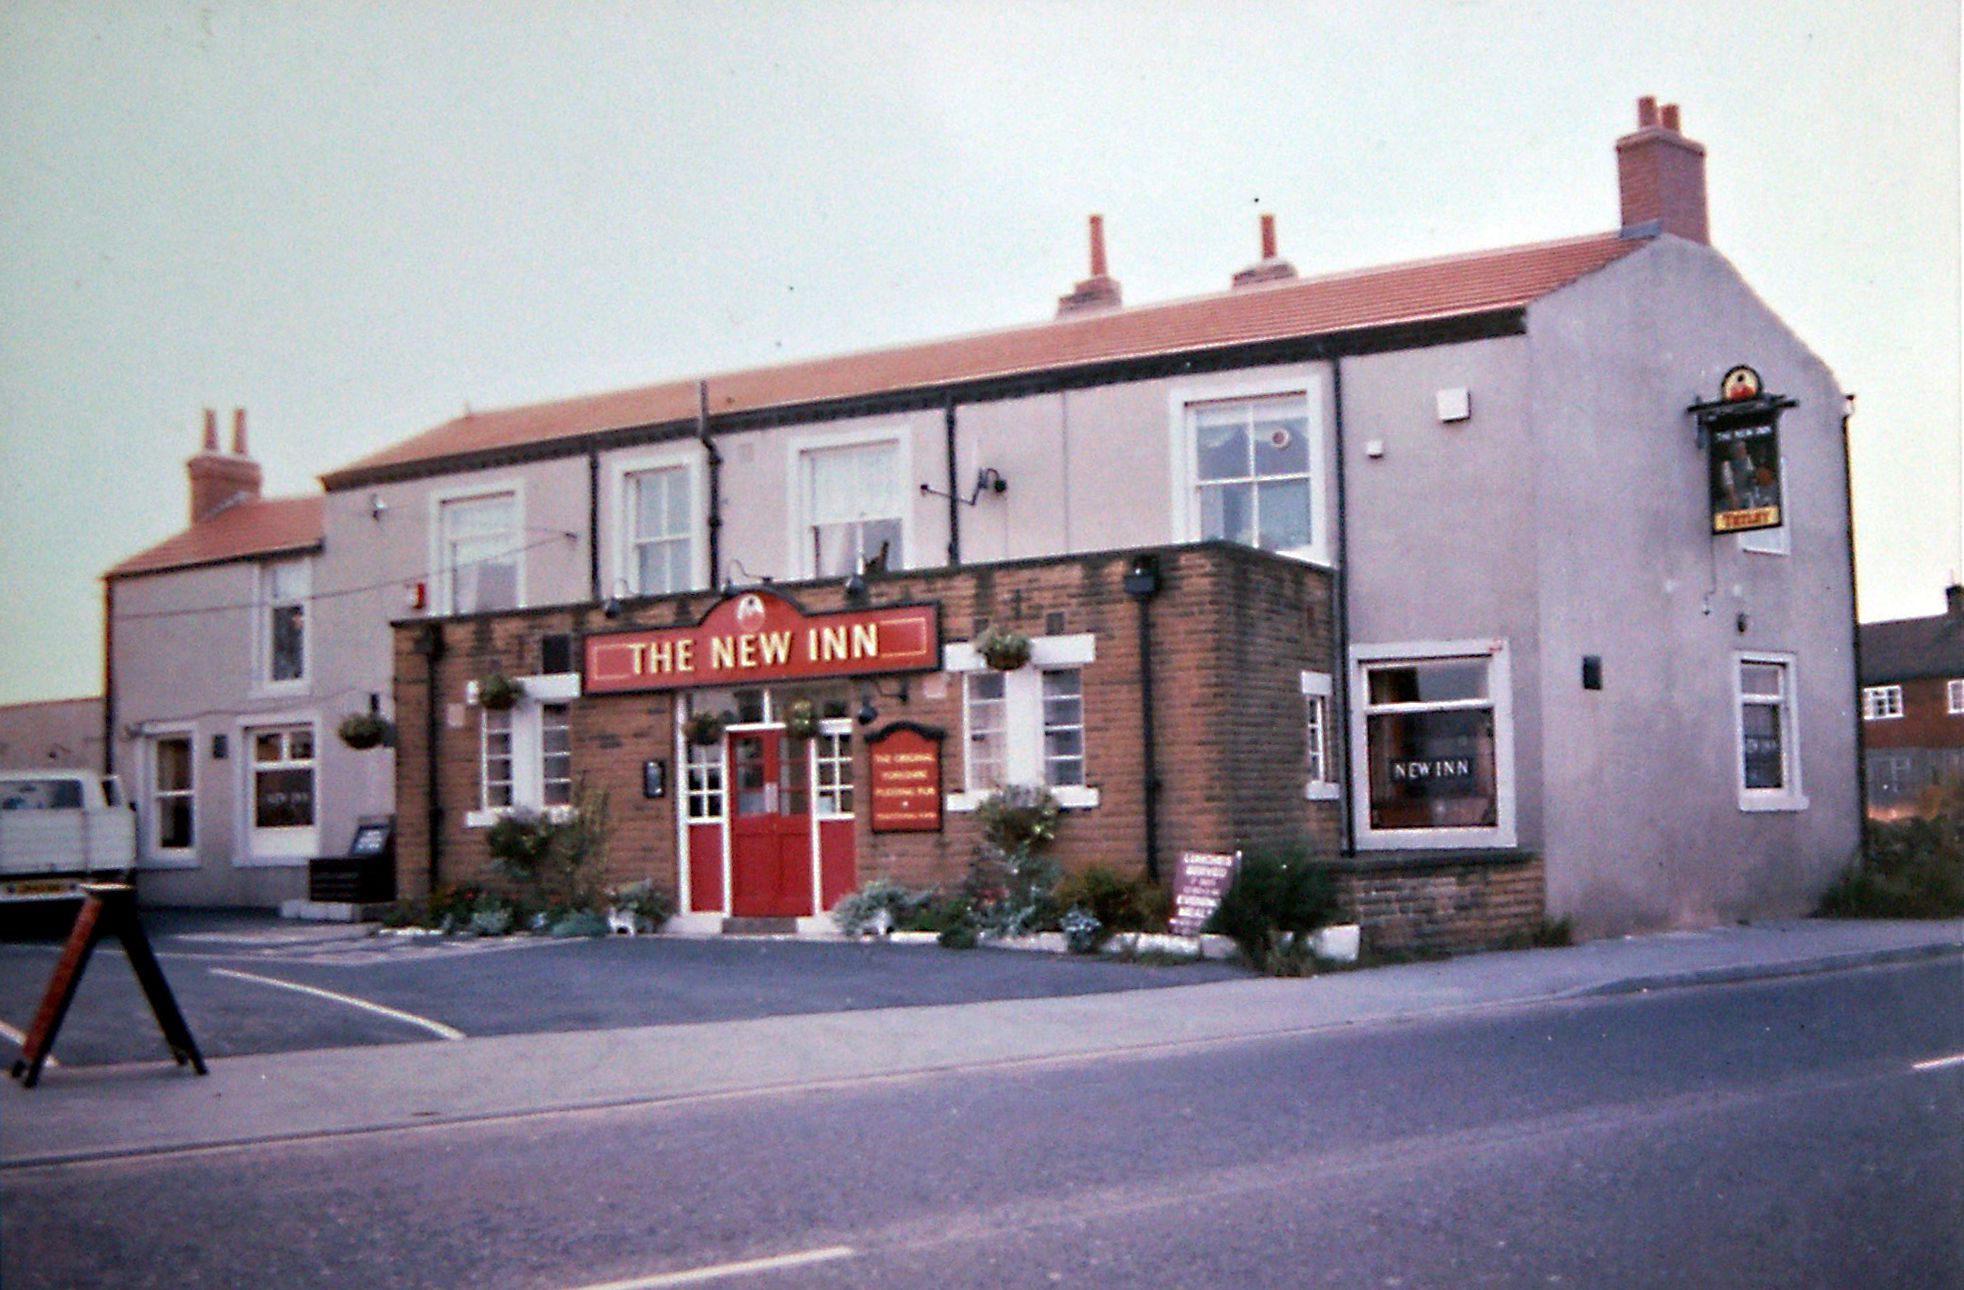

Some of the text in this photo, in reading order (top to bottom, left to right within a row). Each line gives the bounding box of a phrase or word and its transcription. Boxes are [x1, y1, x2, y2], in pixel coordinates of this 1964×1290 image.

[628, 623, 879, 675] THE NEW INN
[1394, 759, 1470, 779] NEW INN
